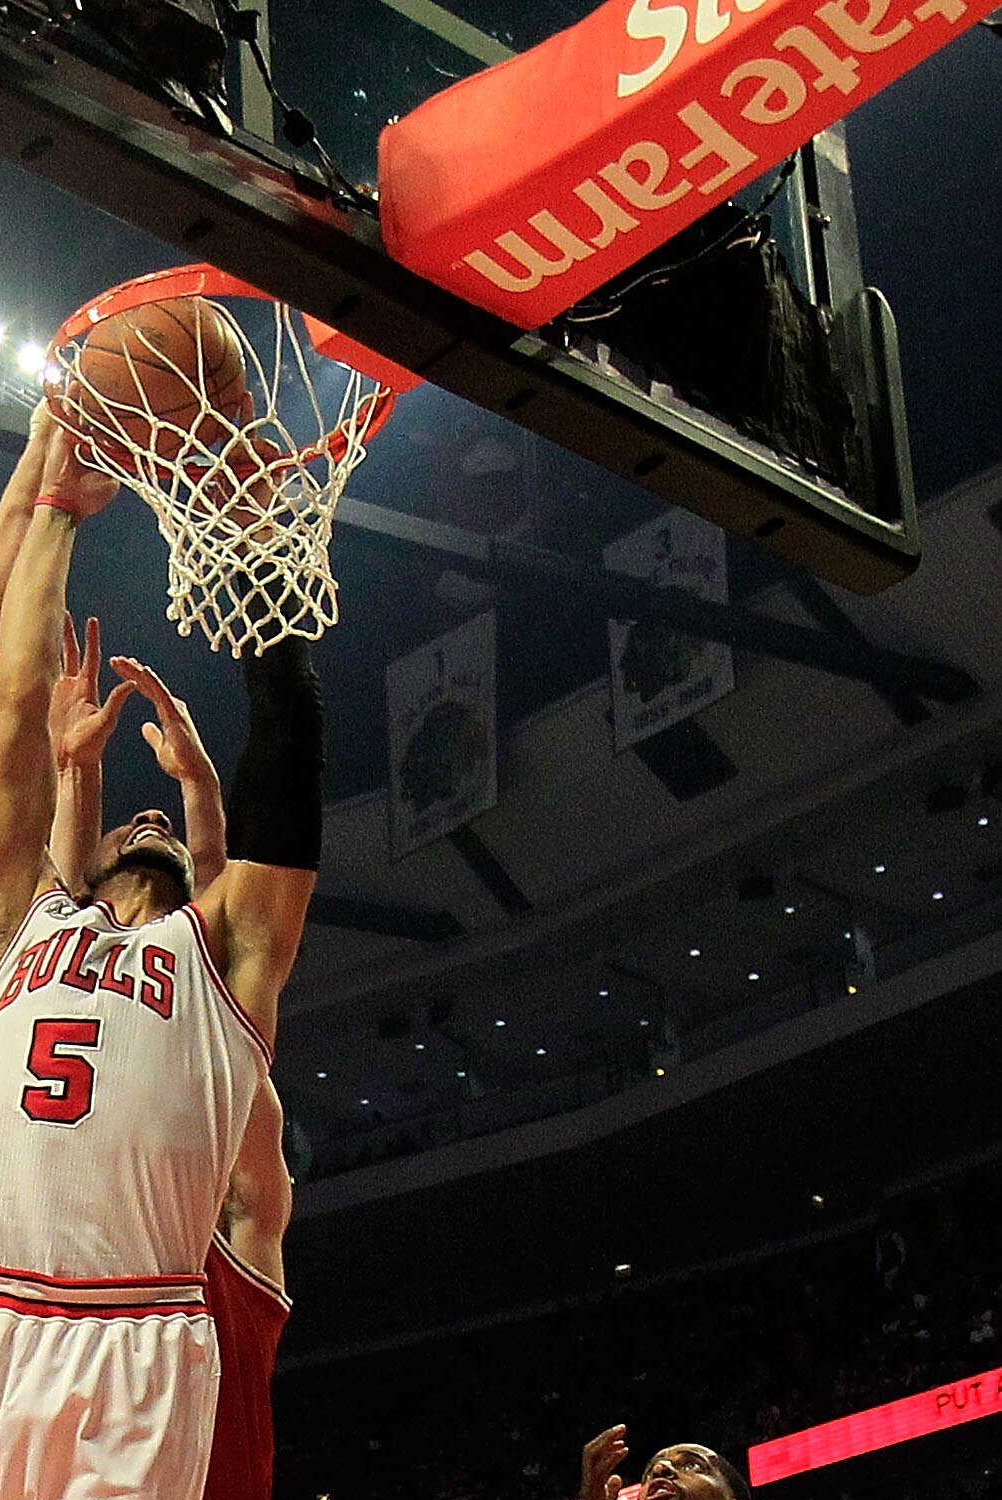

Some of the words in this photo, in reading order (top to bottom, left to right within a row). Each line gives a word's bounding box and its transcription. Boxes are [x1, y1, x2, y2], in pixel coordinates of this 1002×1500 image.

[463, 101, 759, 293] Farm
[20, 1014, 103, 1129] 5
[935, 1382, 982, 1414] PUT
